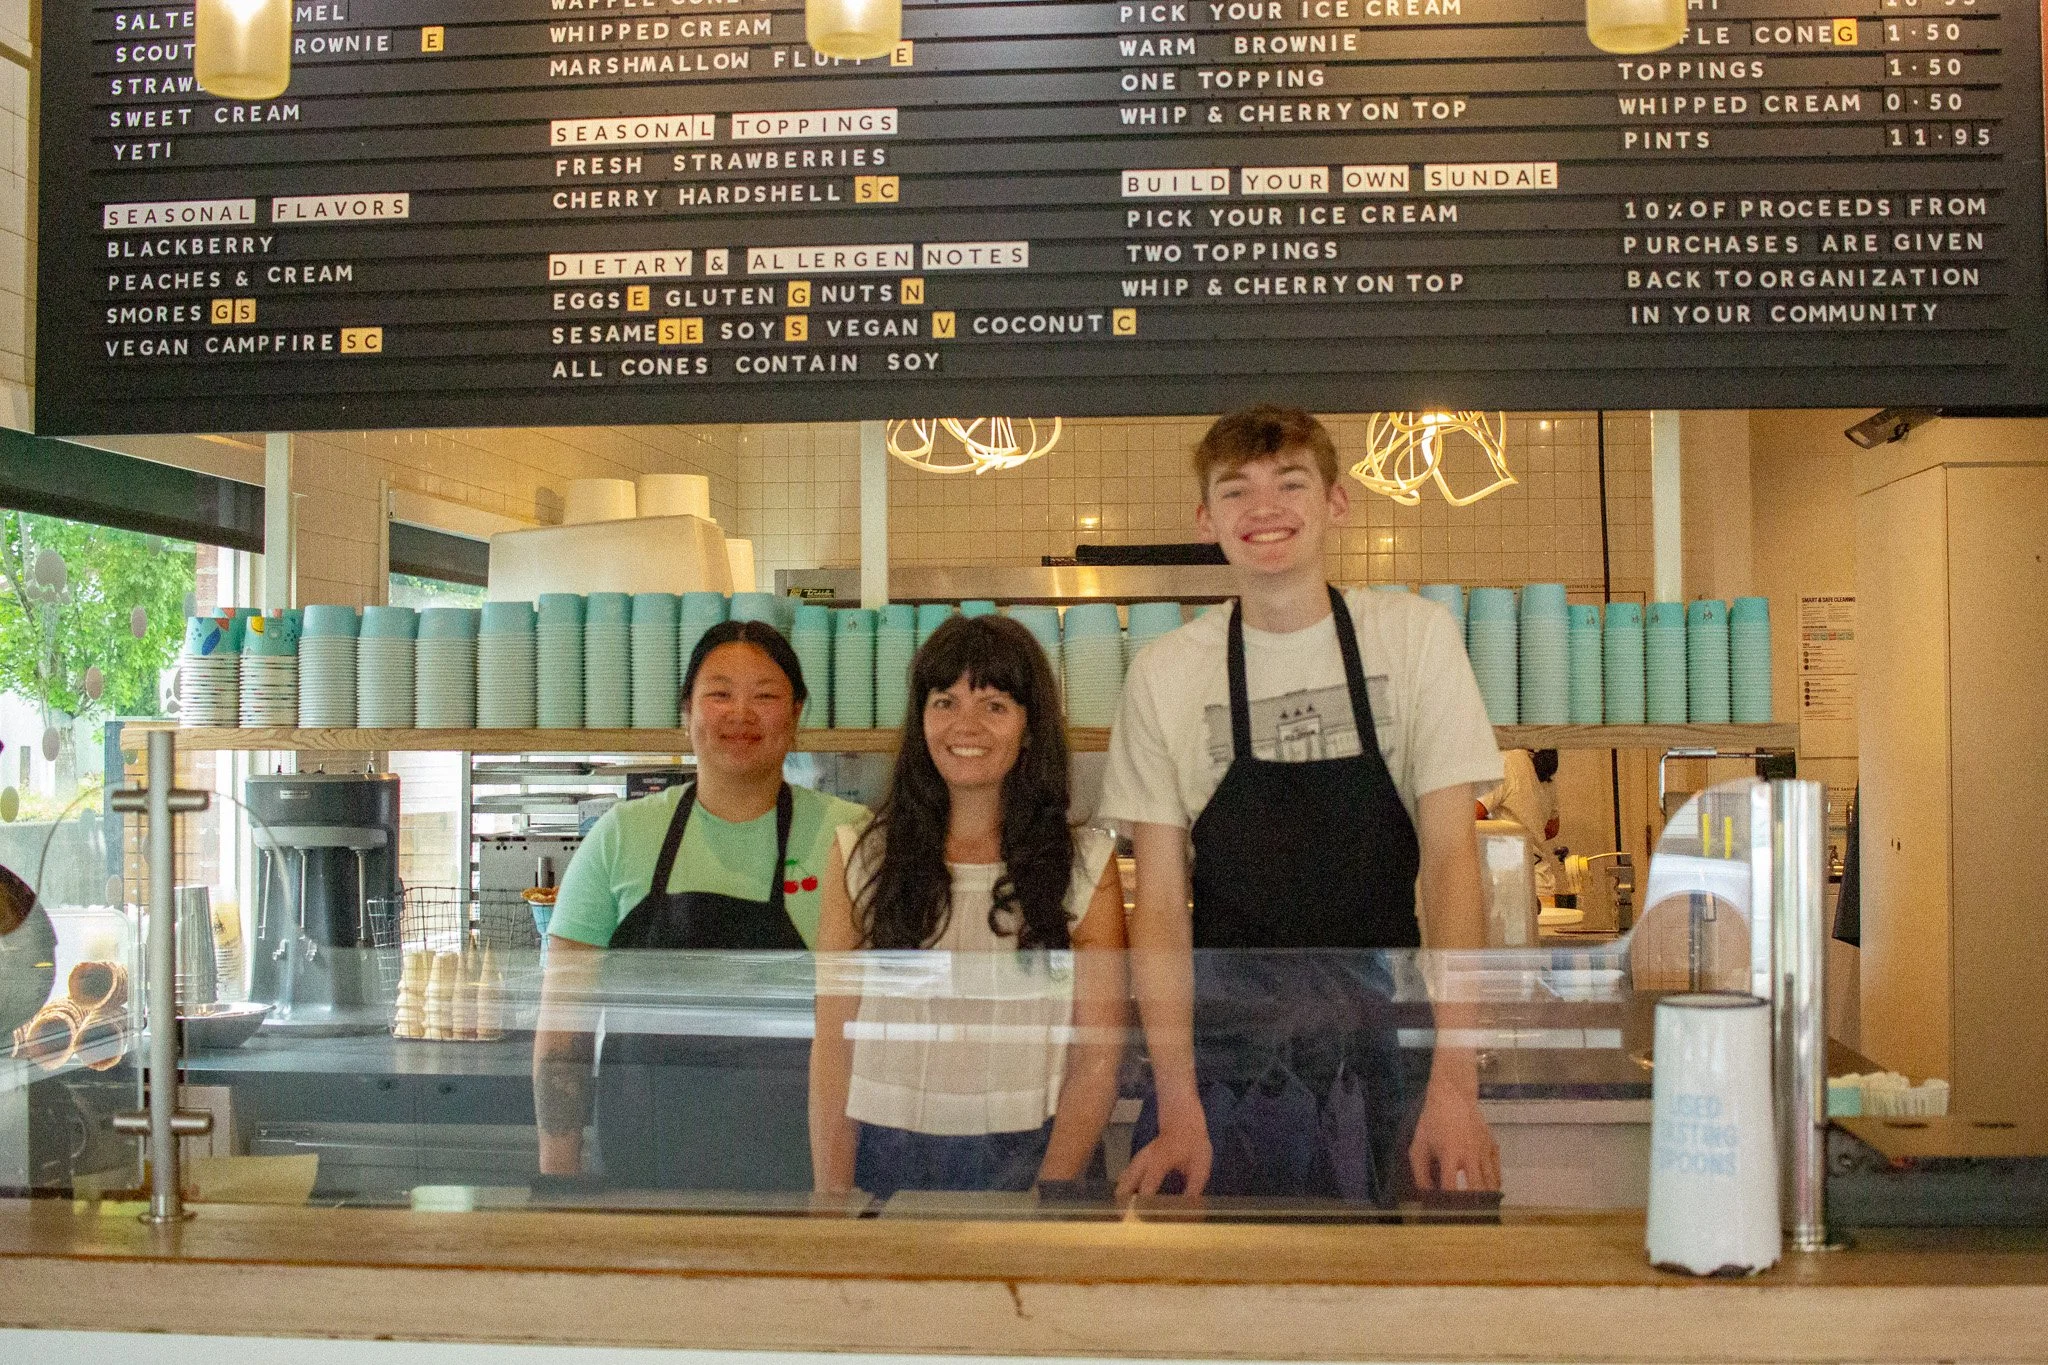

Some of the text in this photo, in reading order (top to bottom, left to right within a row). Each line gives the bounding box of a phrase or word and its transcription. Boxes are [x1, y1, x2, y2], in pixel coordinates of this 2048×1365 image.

[116, 5, 343, 30] SALTE MEL
[1121, 0, 1460, 22] PICK YOUR ICE CREAM
[550, 19, 770, 42] WHIPPED CREAM
[1679, 25, 1729, 44] FLE
[1755, 27, 1833, 44] CONE
[295, 36, 388, 54] ROWNIE
[1119, 34, 1357, 56] WARM BROWNIE
[550, 53, 748, 76] MARSHMALLOW
[773, 50, 864, 67] FLU
[1618, 61, 1763, 80] TOPPINGS
[1122, 69, 1324, 91] ONE TOPPING
[1121, 101, 1466, 124] WHIP & CHERRY ON TOP
[1619, 96, 1747, 115] WHIPPED
[1765, 94, 1860, 112] CREAM
[111, 105, 298, 127] SWEET CREAM
[556, 116, 893, 142] SEASONAL TOPPINGS
[114, 142, 170, 160] YETI
[1625, 132, 1709, 149] PINTS
[557, 149, 884, 176] FRESH STRAWBERRIES
[1128, 169, 1551, 192] BUILD YOUR OWN SUNDAE
[553, 190, 657, 208] CHERRY
[679, 185, 840, 205] HARDSHELL
[109, 200, 404, 225] SEASONAL FLAVORS
[1128, 205, 1457, 227] PICK YOUR ICE CREAM
[1741, 199, 1890, 218] PROCEEDS
[1911, 198, 1985, 216] FROM
[108, 237, 272, 257] BLACKBERRY
[1127, 242, 1337, 262] TWO TOPPINGS
[1624, 233, 1983, 254] PURCHASES ARE GIVEN
[553, 248, 1023, 277] DIETARY & ALLERGEN NOTES
[109, 265, 352, 290] PEACHES & CREAM
[1122, 274, 1463, 296] WHIP & CHERRY ON TOP
[1628, 271, 1700, 288] BACK
[554, 292, 619, 310] EGGS
[666, 288, 773, 307] GLUTEN
[822, 285, 892, 302] NUTS
[107, 306, 200, 323] SMORES
[1632, 304, 1937, 323] IN YOUR COMMUNITY
[553, 322, 657, 344] SESAME
[721, 322, 774, 339] SOY
[827, 319, 917, 337] VEGAN
[973, 315, 1102, 334] COCONUT
[106, 339, 187, 356] VEGAN
[206, 334, 332, 353] CAMPFIRE
[553, 353, 938, 377] ALL CONES CONTAIN SOY
